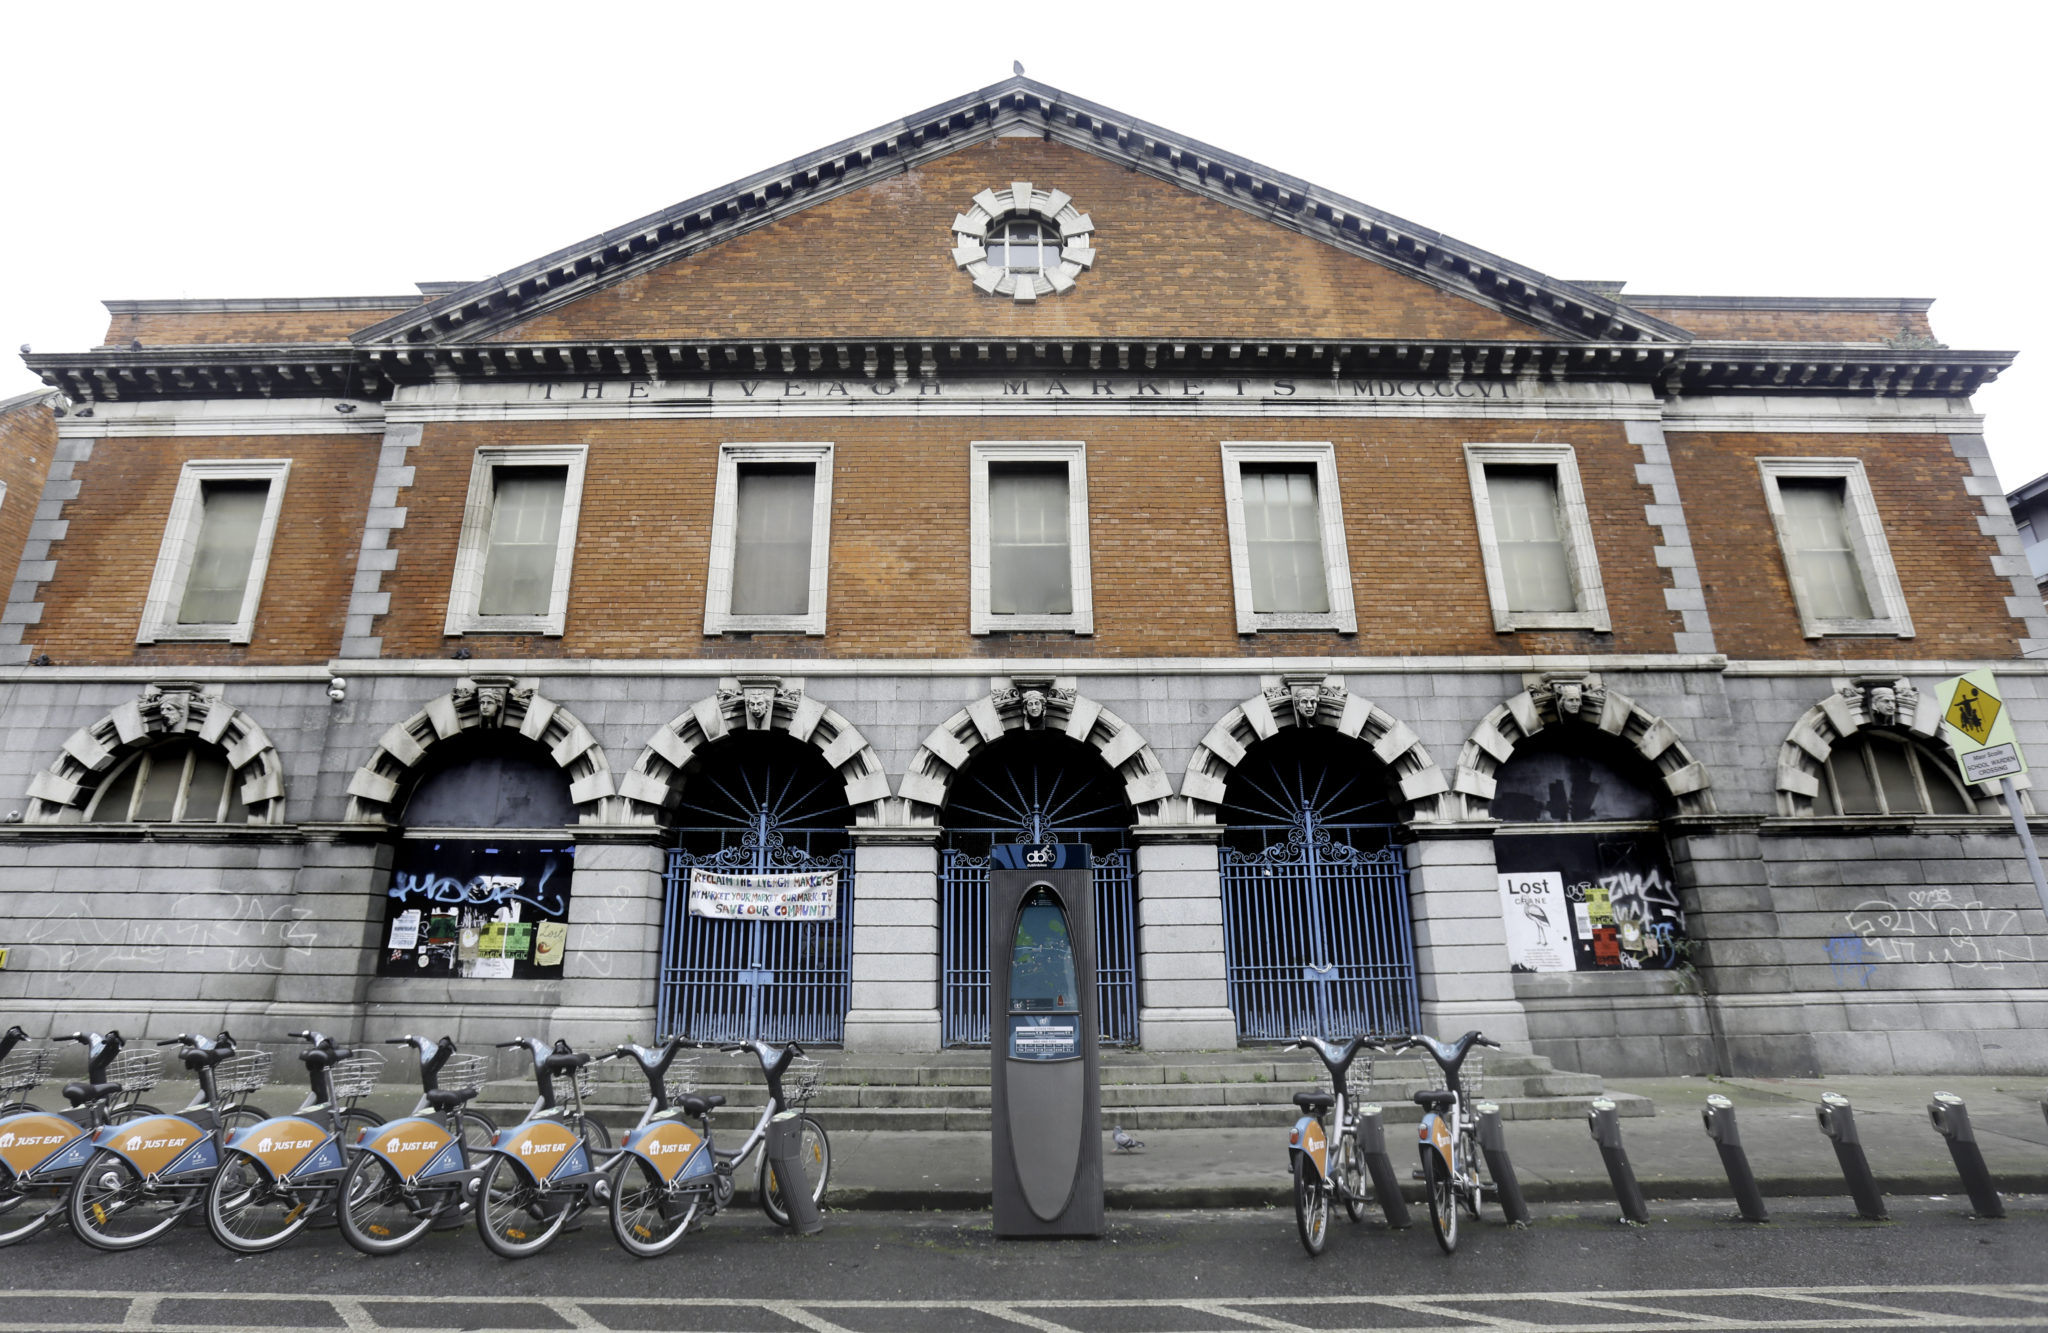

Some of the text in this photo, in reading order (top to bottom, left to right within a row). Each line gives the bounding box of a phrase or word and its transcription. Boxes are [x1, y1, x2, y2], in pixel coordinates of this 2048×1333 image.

[540, 378, 1510, 399] THE IVEAGH MARKETS MDCCCCVI
[1967, 756, 2016, 771] SCHOOL WARDEN
[1979, 765, 2008, 775] CROSSING
[694, 872, 733, 886] RECLAIM
[736, 877, 752, 887] THE
[793, 874, 834, 887] MARKETS
[1508, 879, 1550, 895] Lost
[691, 889, 701, 899] MY
[731, 892, 750, 902] YOUR
[781, 892, 796, 902] OUR
[715, 903, 833, 917] SAVE OUR COMMUNITY
[15, 1135, 64, 1147] JUST EAT
[142, 1138, 187, 1150] JUST EAT
[273, 1140, 313, 1152] JUST EAT
[400, 1141, 438, 1152] JUST EAT
[533, 1143, 567, 1154] JUST EAT
[661, 1143, 691, 1154] JUST EAT
